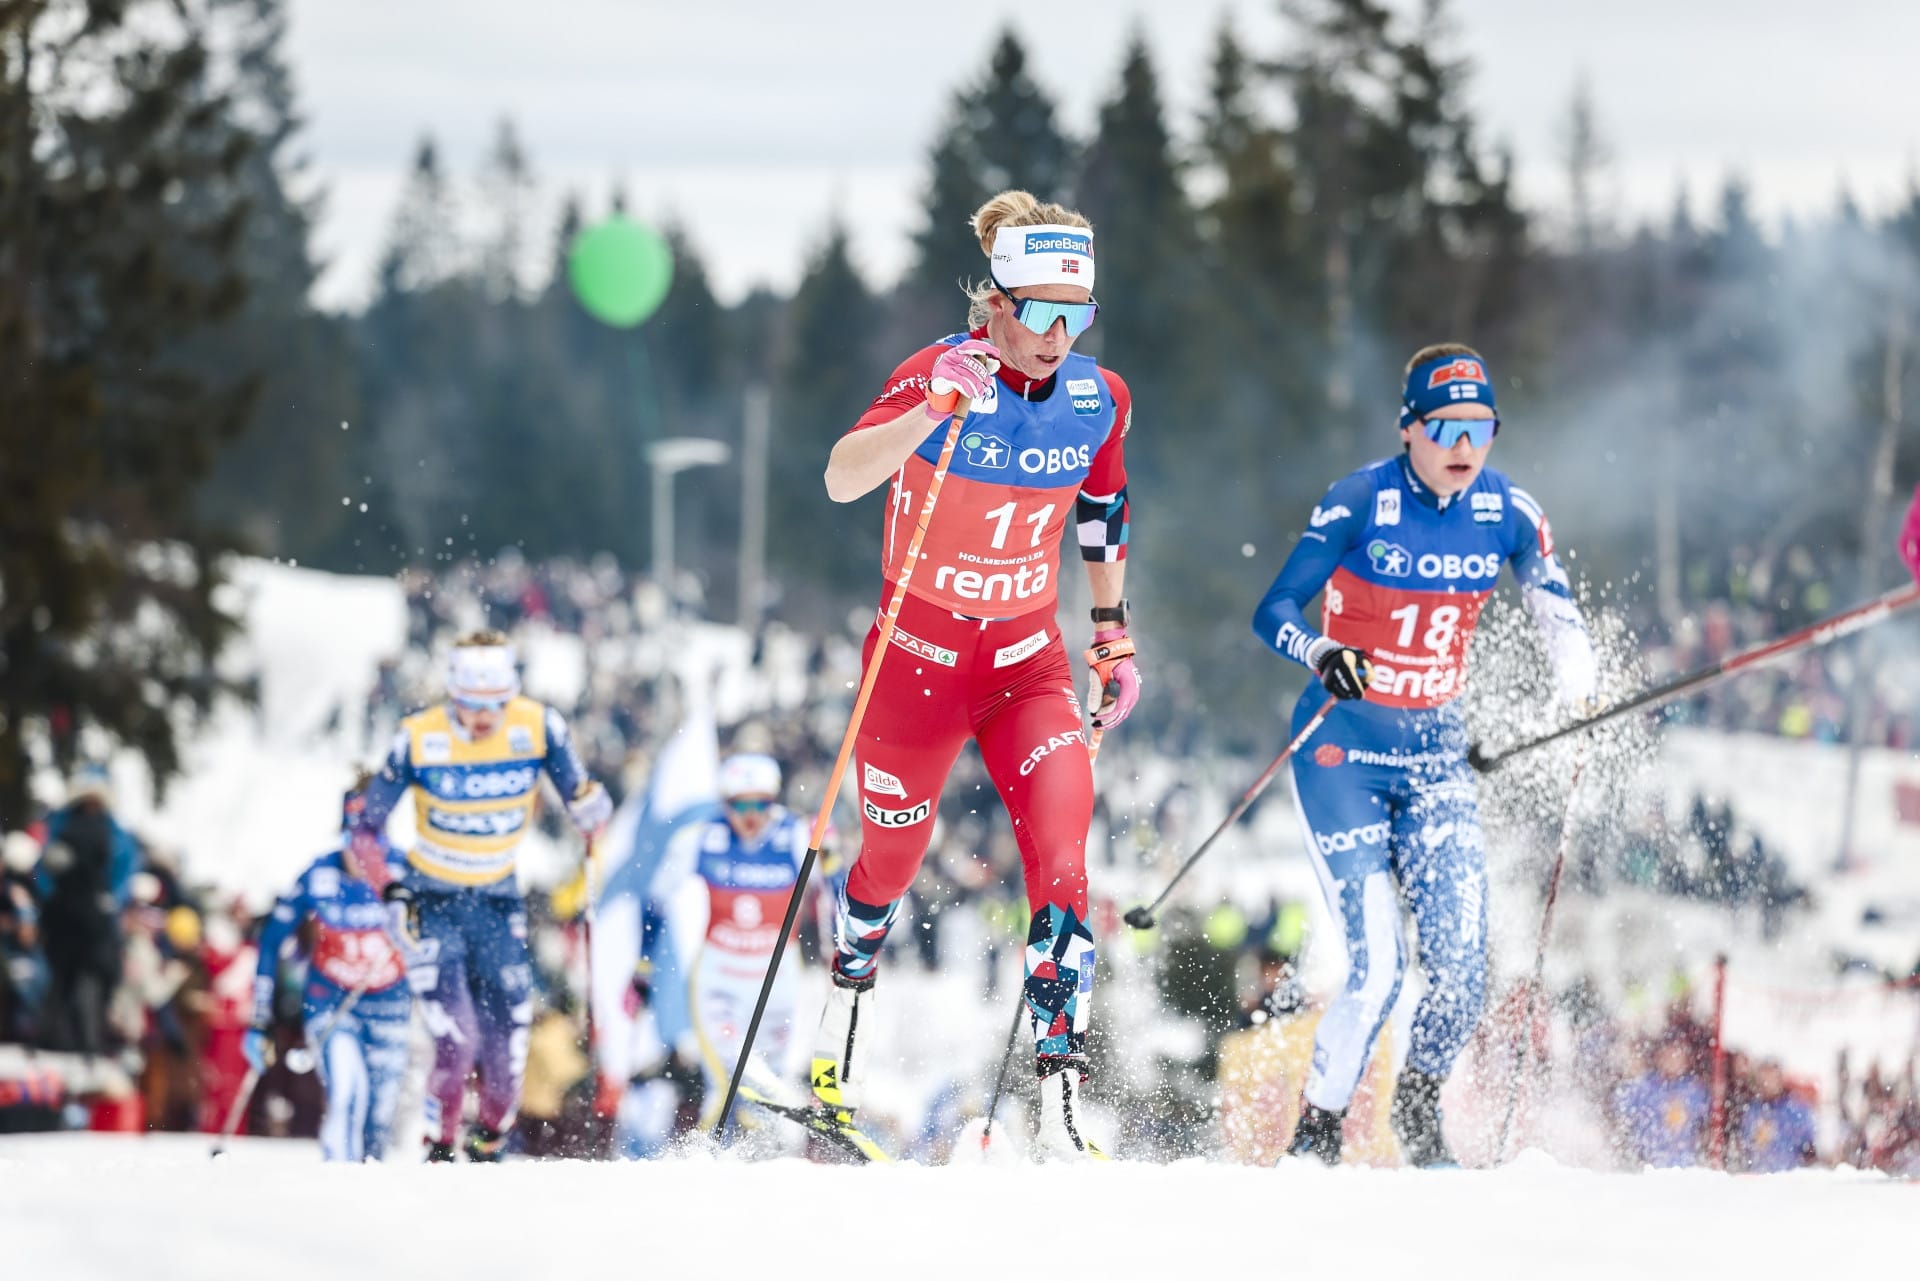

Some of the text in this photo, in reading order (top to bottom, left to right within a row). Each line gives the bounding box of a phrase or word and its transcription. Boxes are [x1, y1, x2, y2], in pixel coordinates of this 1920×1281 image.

[1073, 399, 1100, 410] coop
[1018, 444, 1090, 475] OBOS
[985, 502, 1056, 550] 11
[935, 563, 1049, 601] renta
[1417, 552, 1499, 579] OBOS
[1276, 621, 1313, 663] FIN
[1390, 603, 1461, 651] 18
[1001, 633, 1043, 661] Scandic
[1368, 664, 1457, 698] enta
[1019, 728, 1084, 776] CRAFT
[867, 768, 898, 787] Gilde
